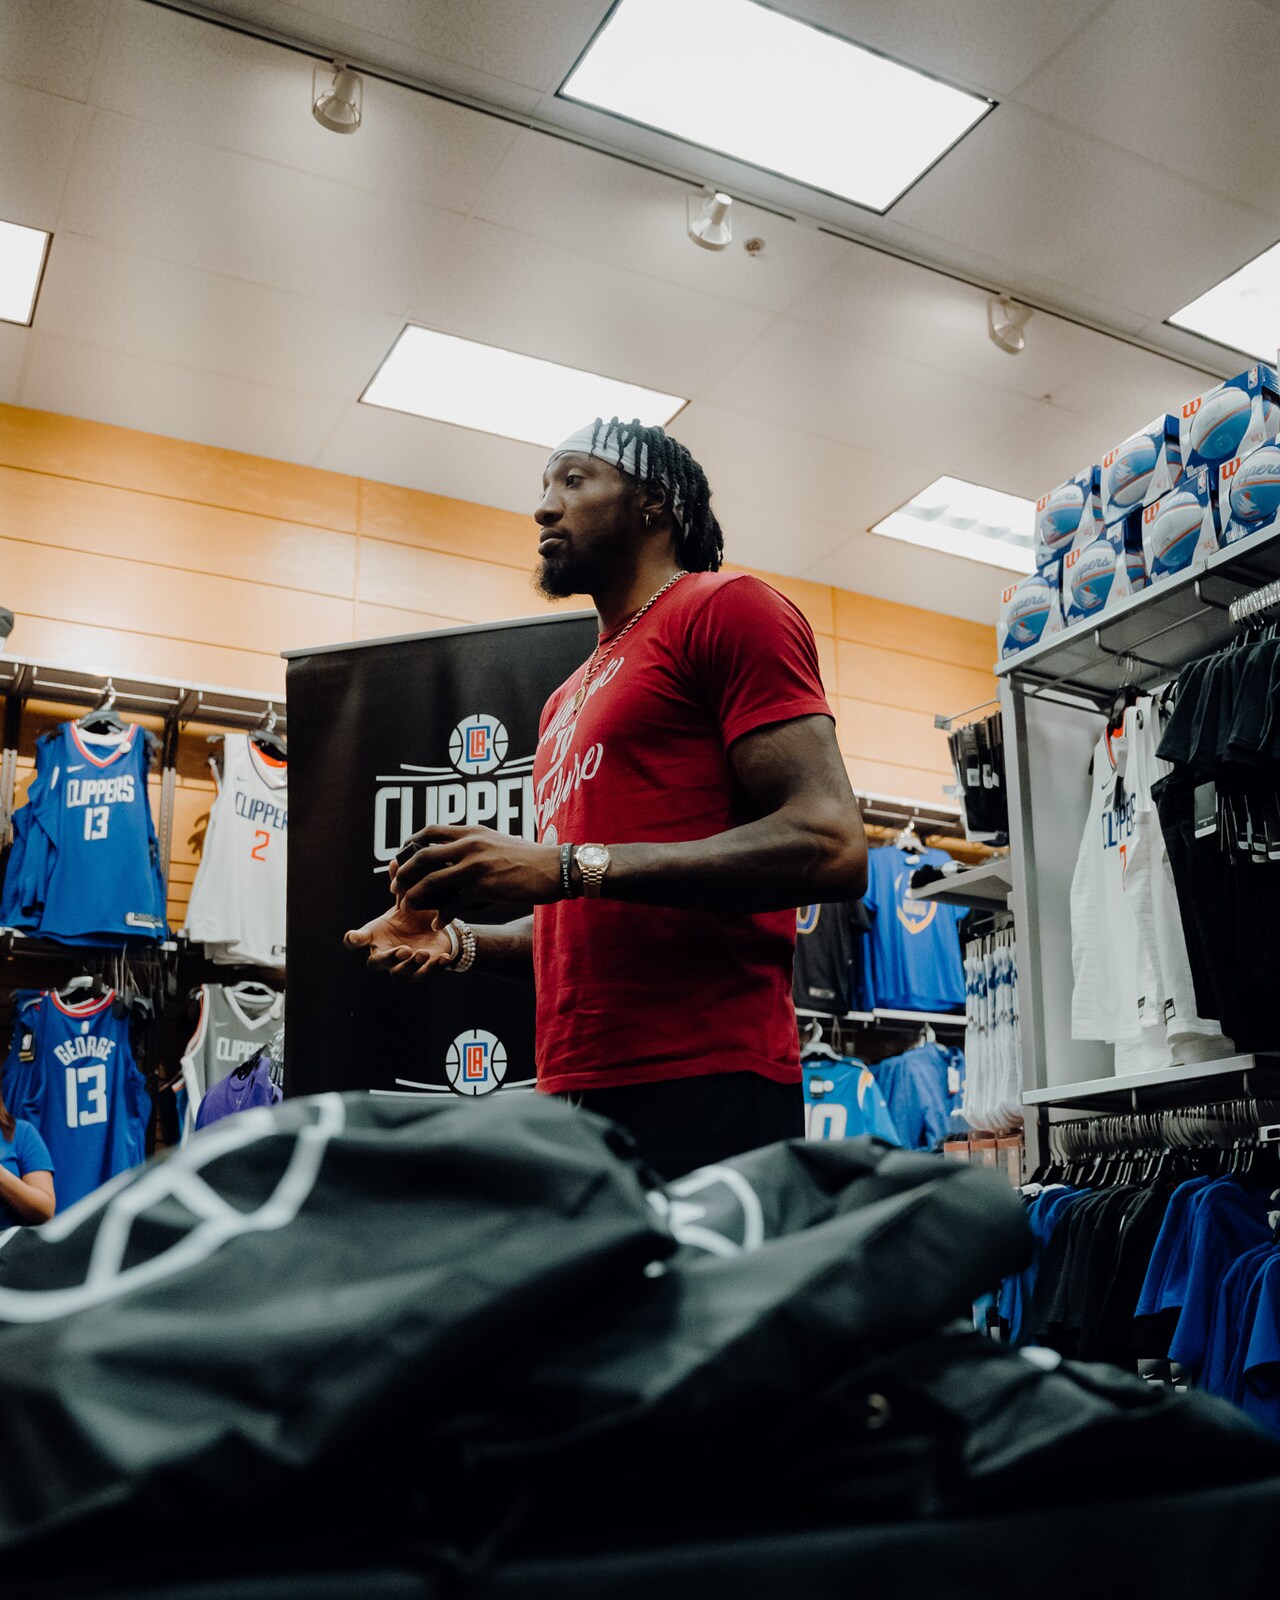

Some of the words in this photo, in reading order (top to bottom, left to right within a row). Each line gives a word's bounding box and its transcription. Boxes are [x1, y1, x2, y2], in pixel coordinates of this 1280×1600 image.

[66, 775, 135, 808] CLIPPERS
[84, 806, 110, 841] 13
[251, 830, 270, 861] 2
[53, 1035, 116, 1066] GEORGE
[217, 1036, 266, 1062] CLIPP
[65, 1064, 108, 1128] 13
